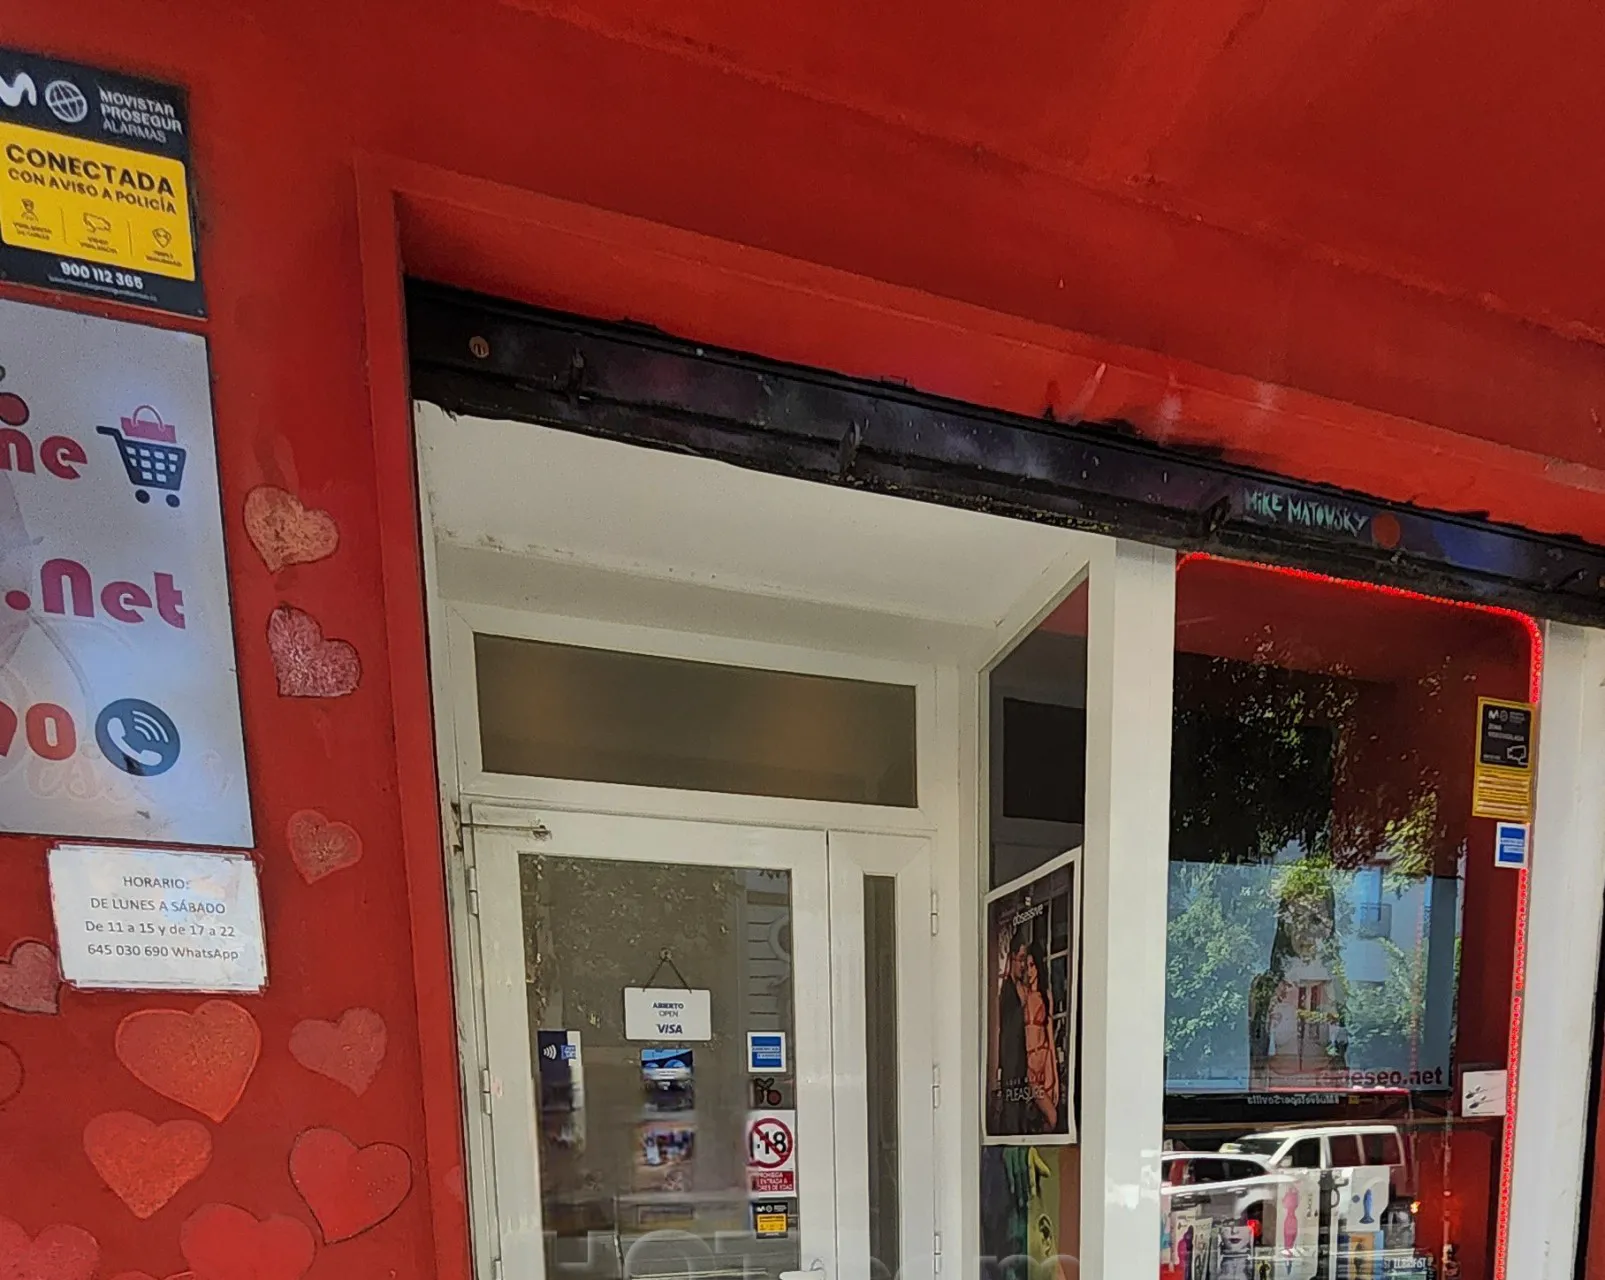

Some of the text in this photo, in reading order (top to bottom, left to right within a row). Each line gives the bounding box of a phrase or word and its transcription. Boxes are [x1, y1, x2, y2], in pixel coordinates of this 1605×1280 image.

[99, 88, 175, 118] MOVISTAR
[100, 103, 183, 135] PROSEGUR
[103, 118, 167, 144] ALARMAS
[5, 143, 176, 198] CONECTADA
[8, 167, 177, 215] CON AVISO A POLICÍA
[60, 261, 89, 280] 900
[93, 268, 111, 285] 112
[123, 876, 191, 890] HORARIO:
[91, 898, 226, 914] DE LUNES A SÁBADO
[85, 921, 235, 938] De 11 a 15 y de 17 a 22
[87, 943, 239, 961] 645 030 690 WhatsApp
[656, 1024, 683, 1034] VISA
[1006, 1085, 1045, 1104] PLEASURE
